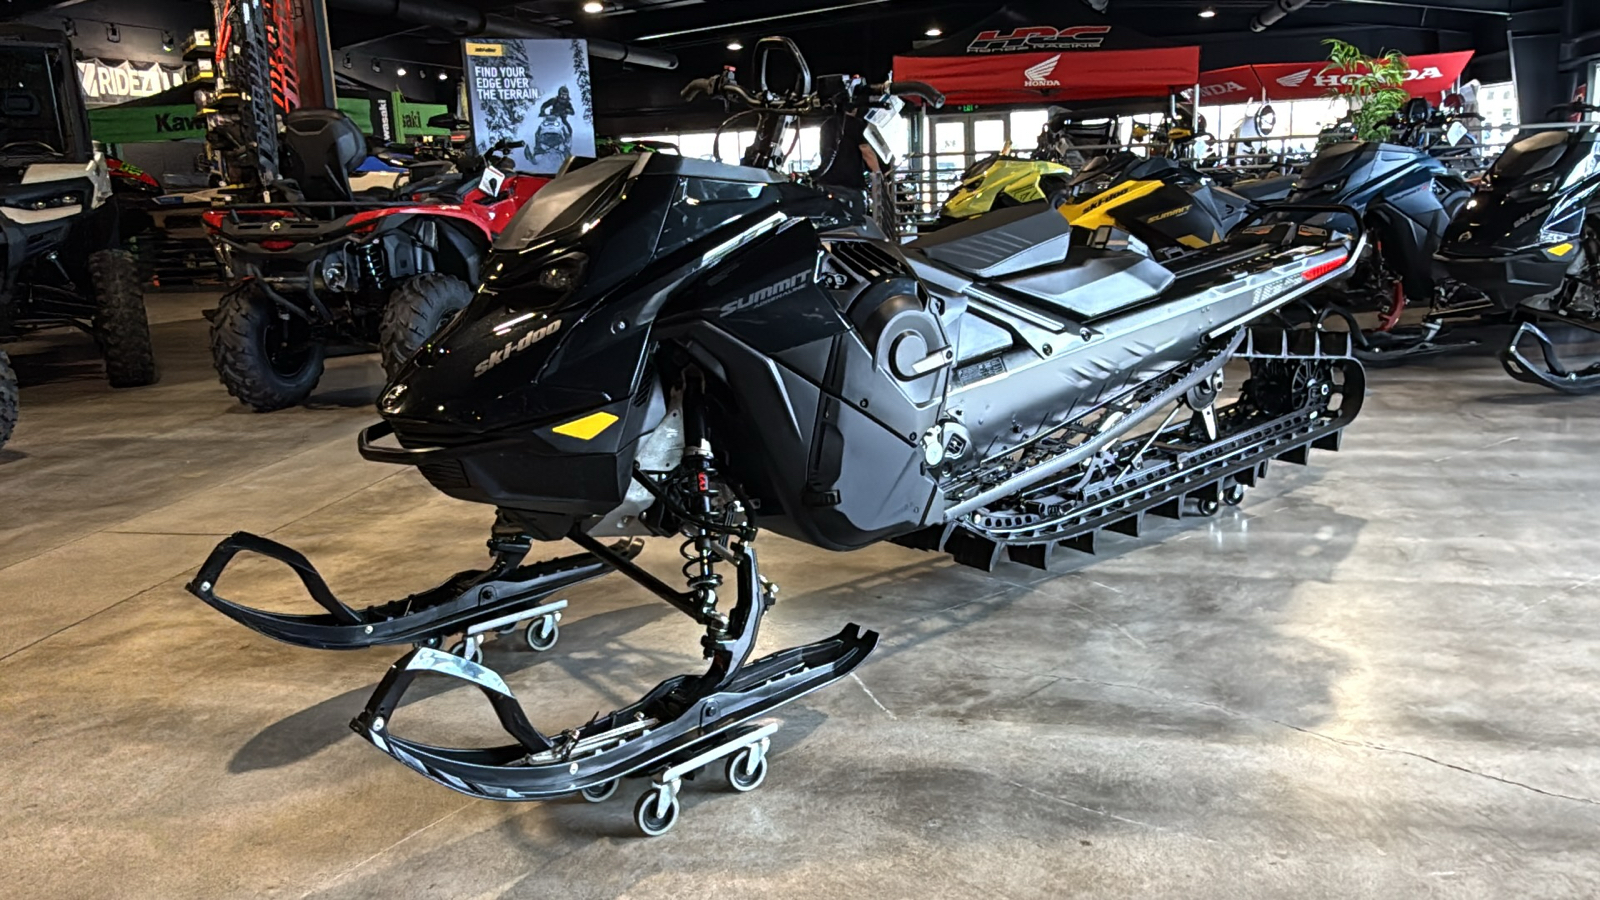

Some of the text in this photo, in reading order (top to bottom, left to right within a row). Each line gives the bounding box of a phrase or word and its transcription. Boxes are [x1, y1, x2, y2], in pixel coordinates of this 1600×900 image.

[475, 66, 525, 77] FIND YOUR
[476, 77, 529, 89] EDGE OVER
[477, 88, 541, 100] THE TERRAIN.
[1082, 188, 1130, 213] ski-doo
[1146, 203, 1193, 224] SUMMIT
[719, 269, 812, 318] SUMMIT
[473, 319, 562, 378] ski-doo
